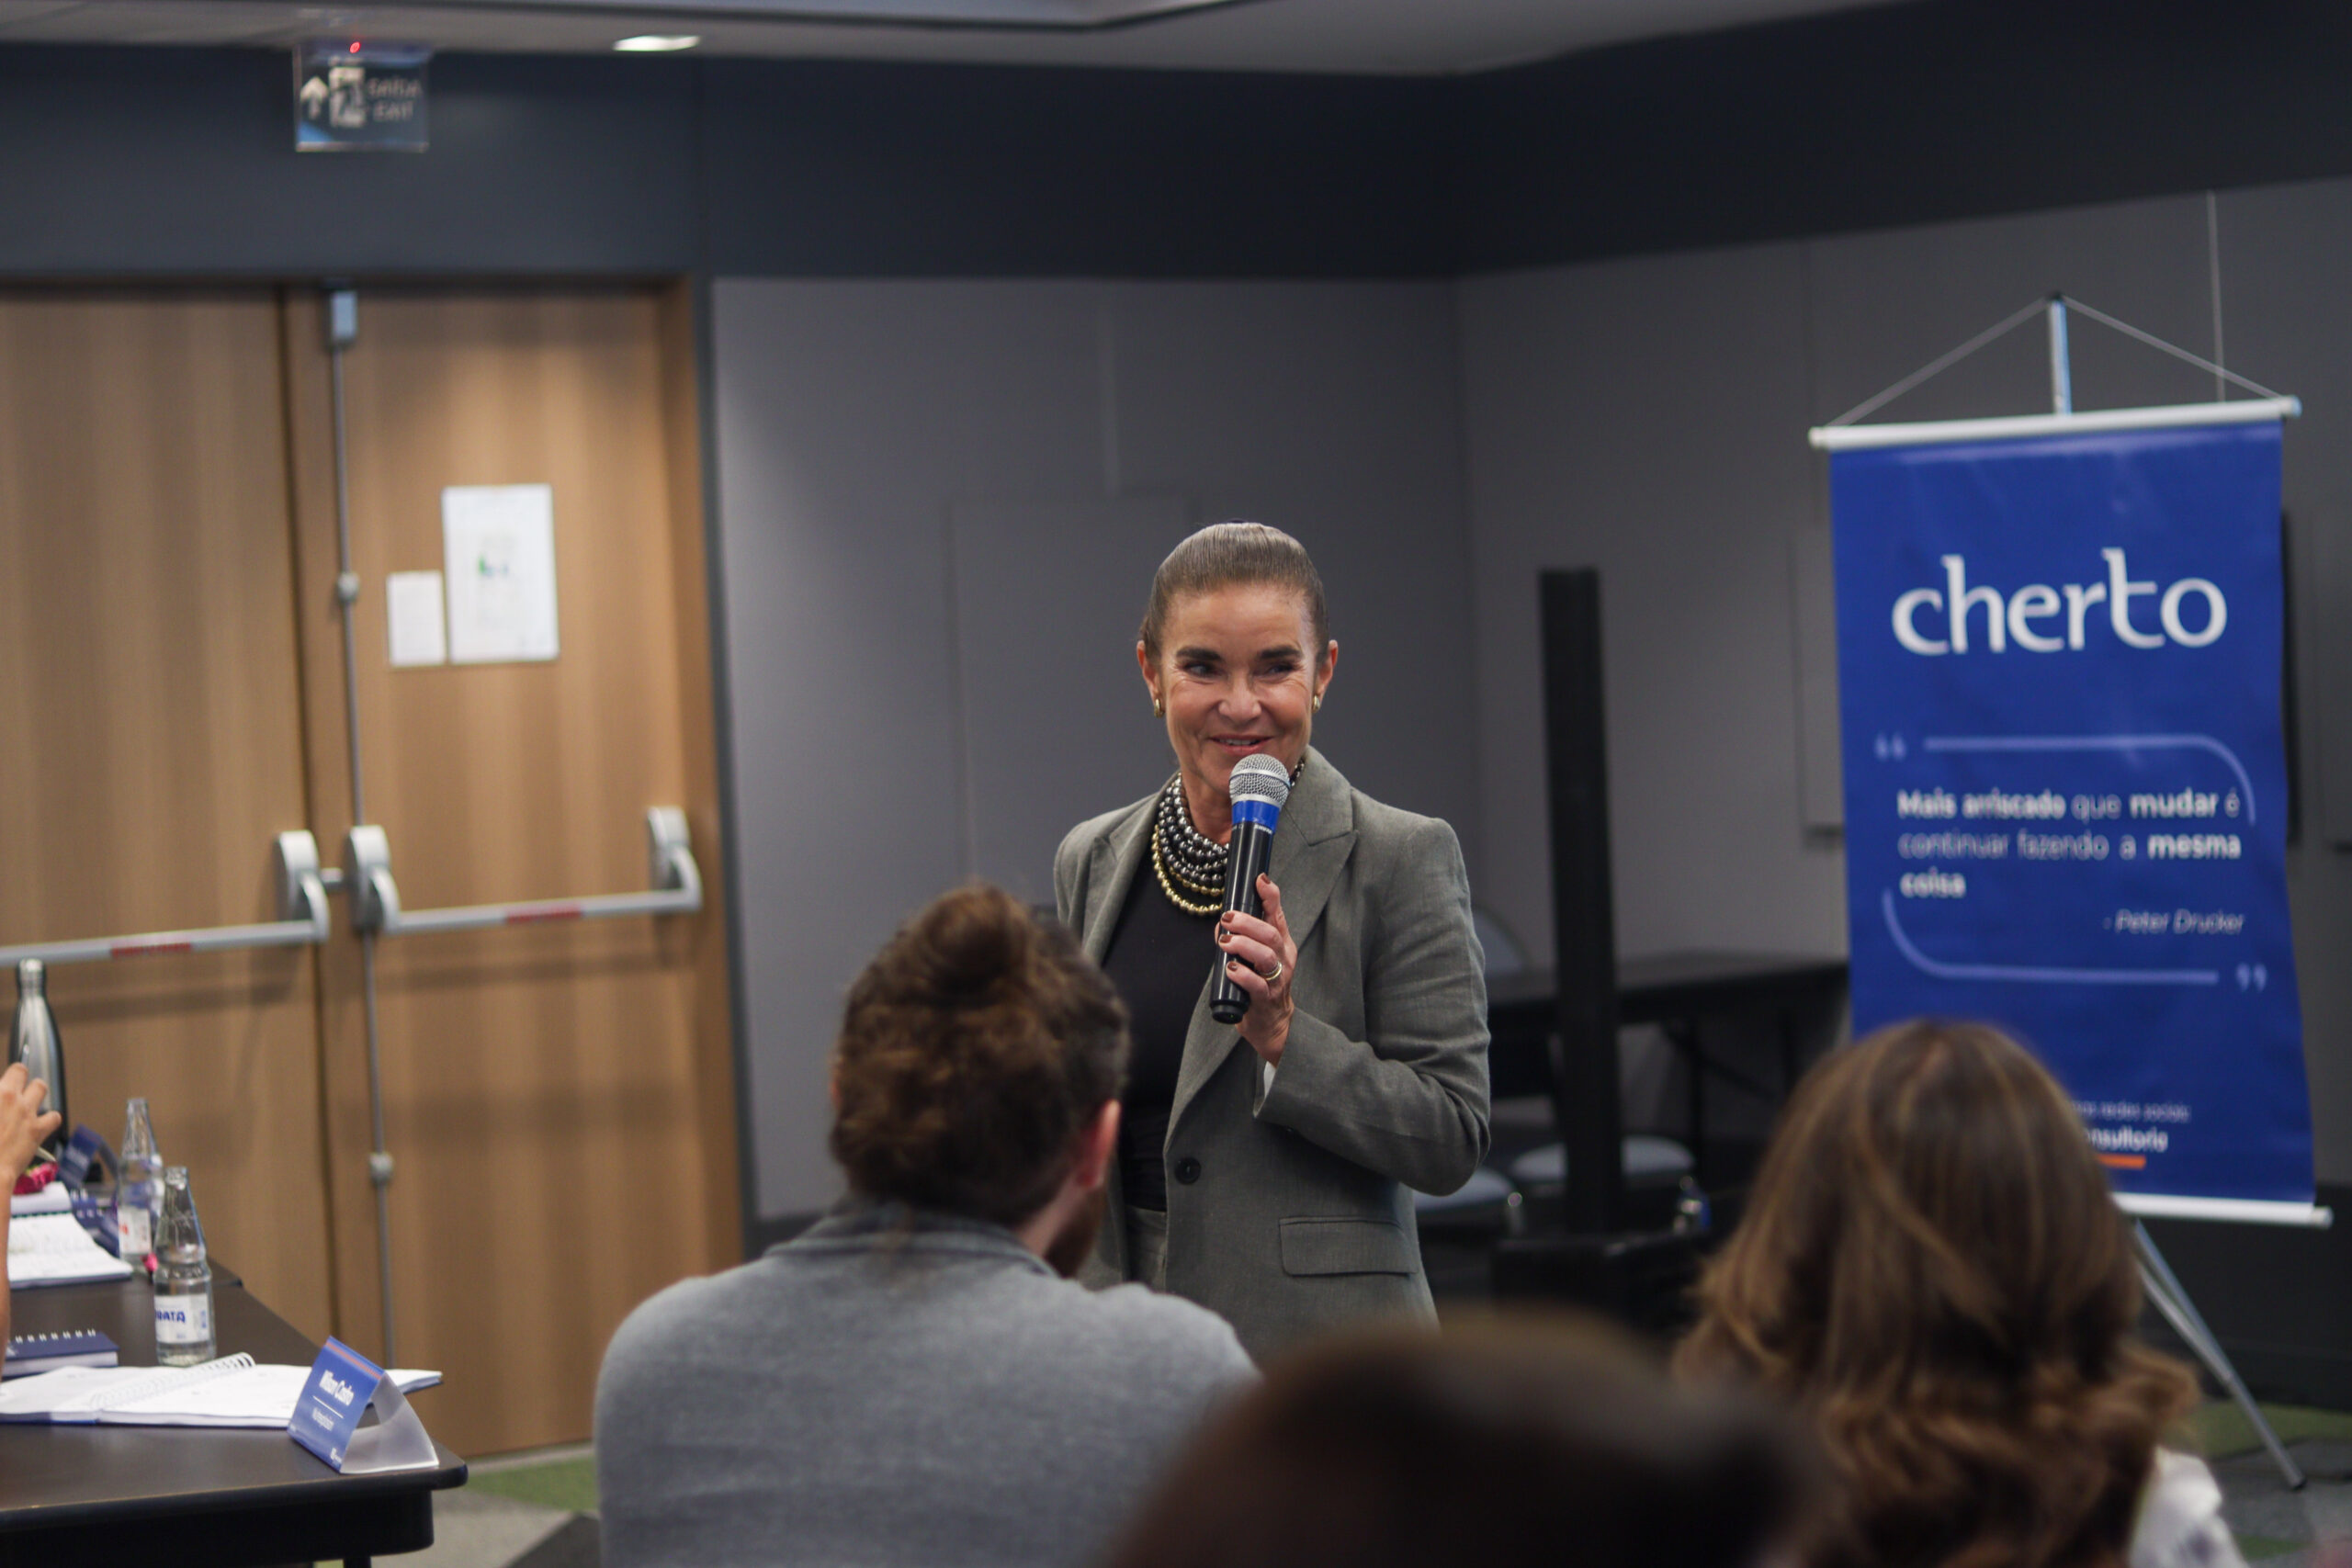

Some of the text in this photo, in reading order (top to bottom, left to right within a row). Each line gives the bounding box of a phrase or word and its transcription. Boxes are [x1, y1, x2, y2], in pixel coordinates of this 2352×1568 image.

[373, 100, 413, 121] EXIT
[1892, 547, 2227, 655] cherto
[1897, 787, 1957, 819] Mais
[1962, 787, 2066, 819] arriscado
[2071, 794, 2122, 825] que
[2130, 787, 2220, 818] mudar
[1898, 829, 2242, 861] continuar fazendo a mesma
[1900, 866, 1966, 898] coisa
[2116, 908, 2169, 934] Peter
[2174, 908, 2245, 934] Drucker
